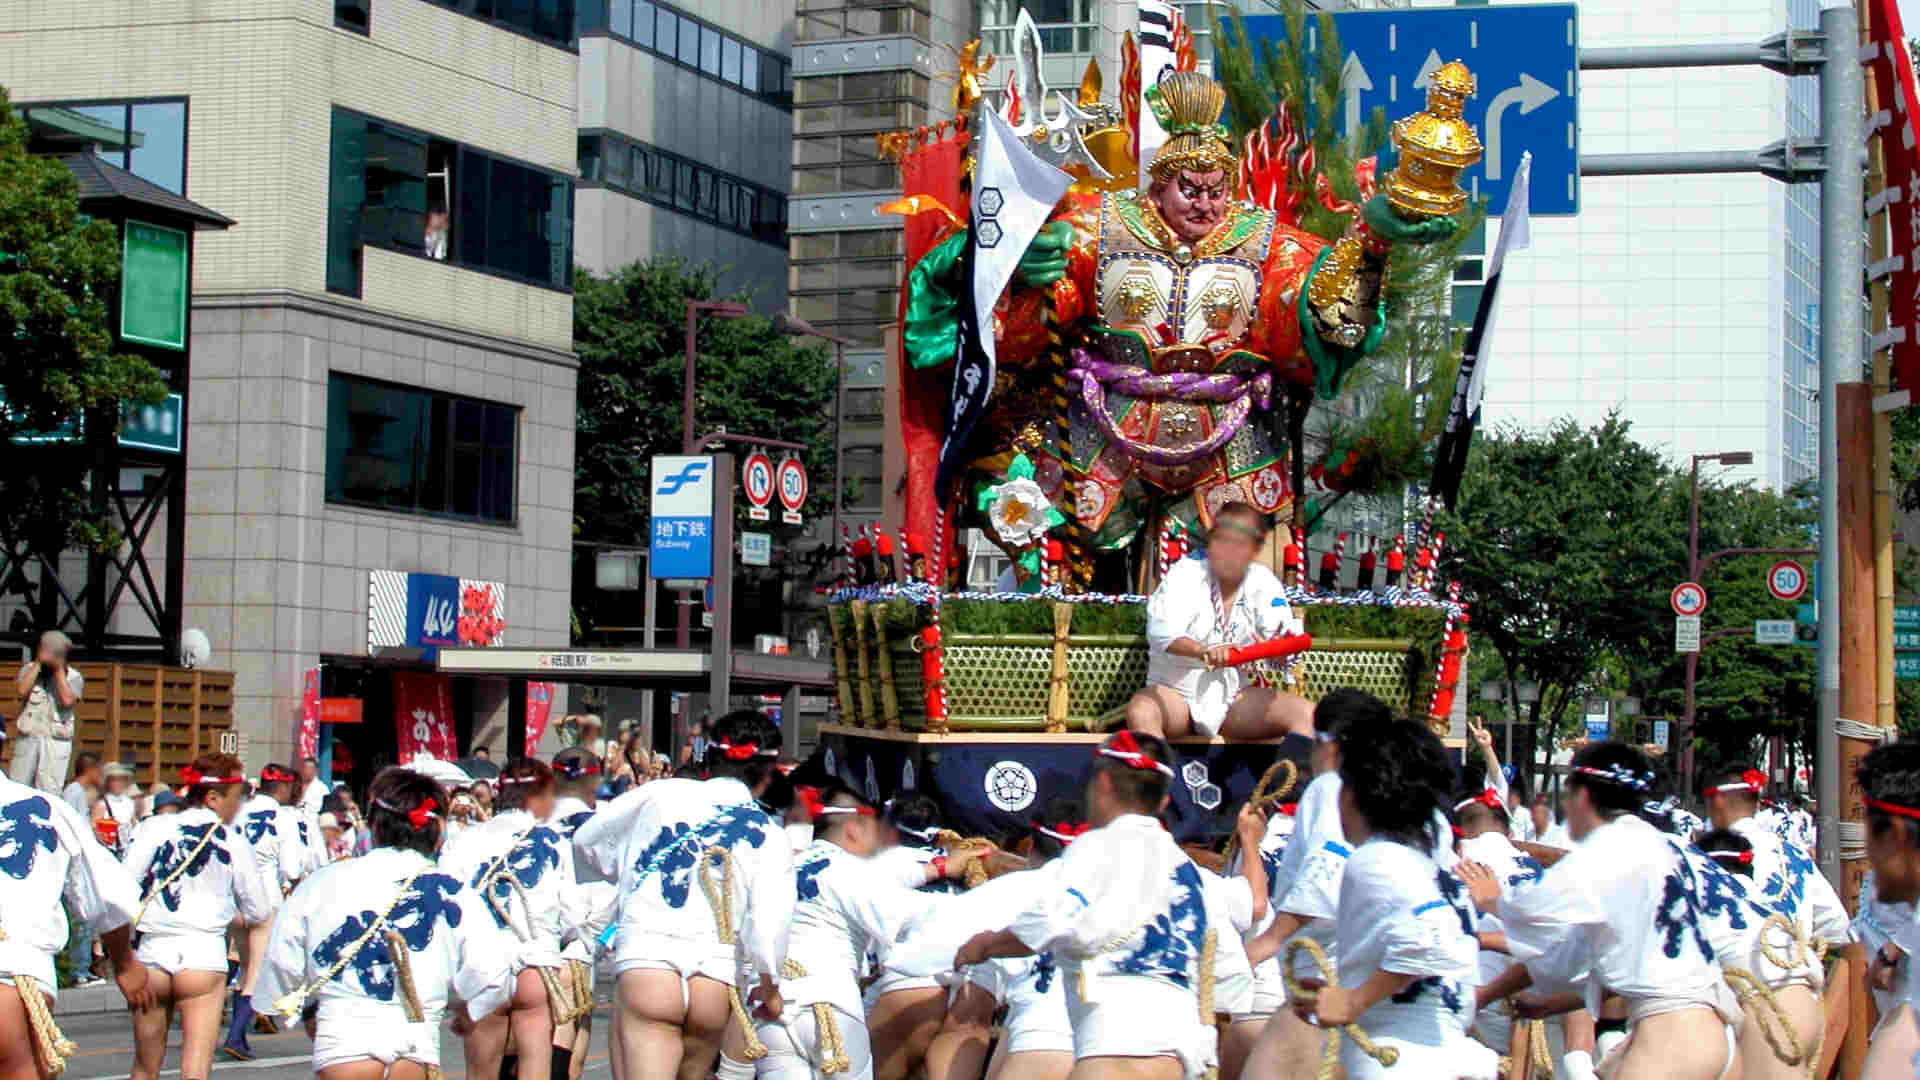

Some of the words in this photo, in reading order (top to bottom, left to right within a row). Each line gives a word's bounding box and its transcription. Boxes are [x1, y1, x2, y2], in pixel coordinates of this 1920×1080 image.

[784, 473, 800, 496] 50
[656, 520, 707, 537] 地下鉄
[1776, 572, 1797, 589] 50
